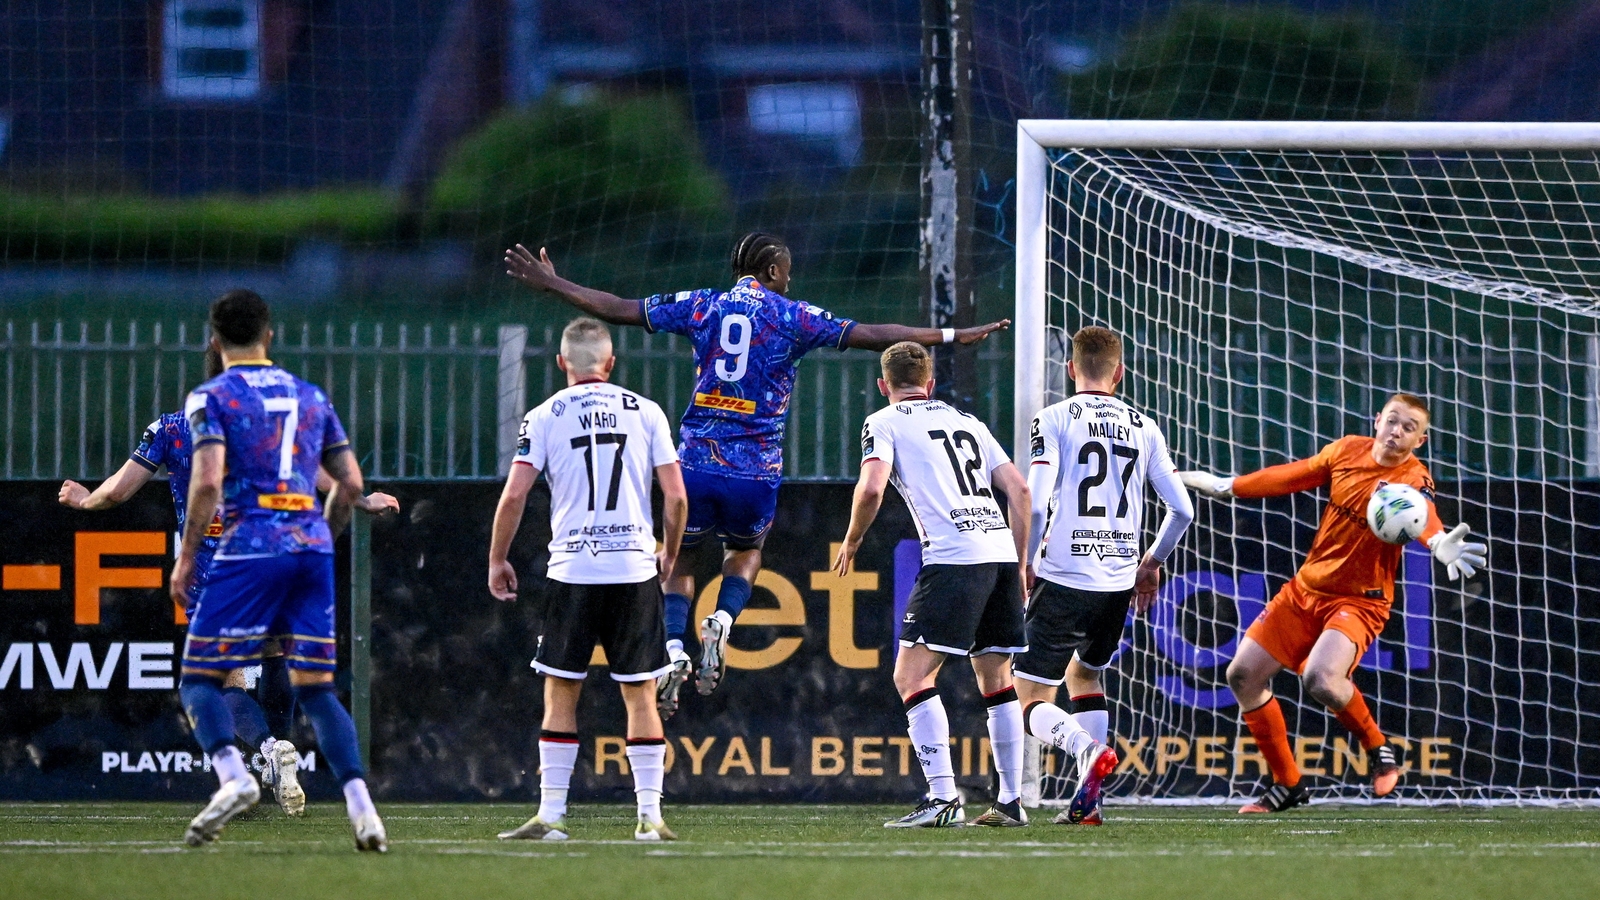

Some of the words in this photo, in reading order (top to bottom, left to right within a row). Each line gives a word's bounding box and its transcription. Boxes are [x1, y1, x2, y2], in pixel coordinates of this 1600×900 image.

[714, 313, 753, 382] 9
[578, 411, 617, 431] WARD
[703, 395, 748, 411] DHL
[1088, 421, 1130, 442] MALLEY
[263, 397, 299, 481] 7
[570, 432, 628, 512] 17
[927, 429, 992, 499] 12
[1077, 440, 1140, 519] 27
